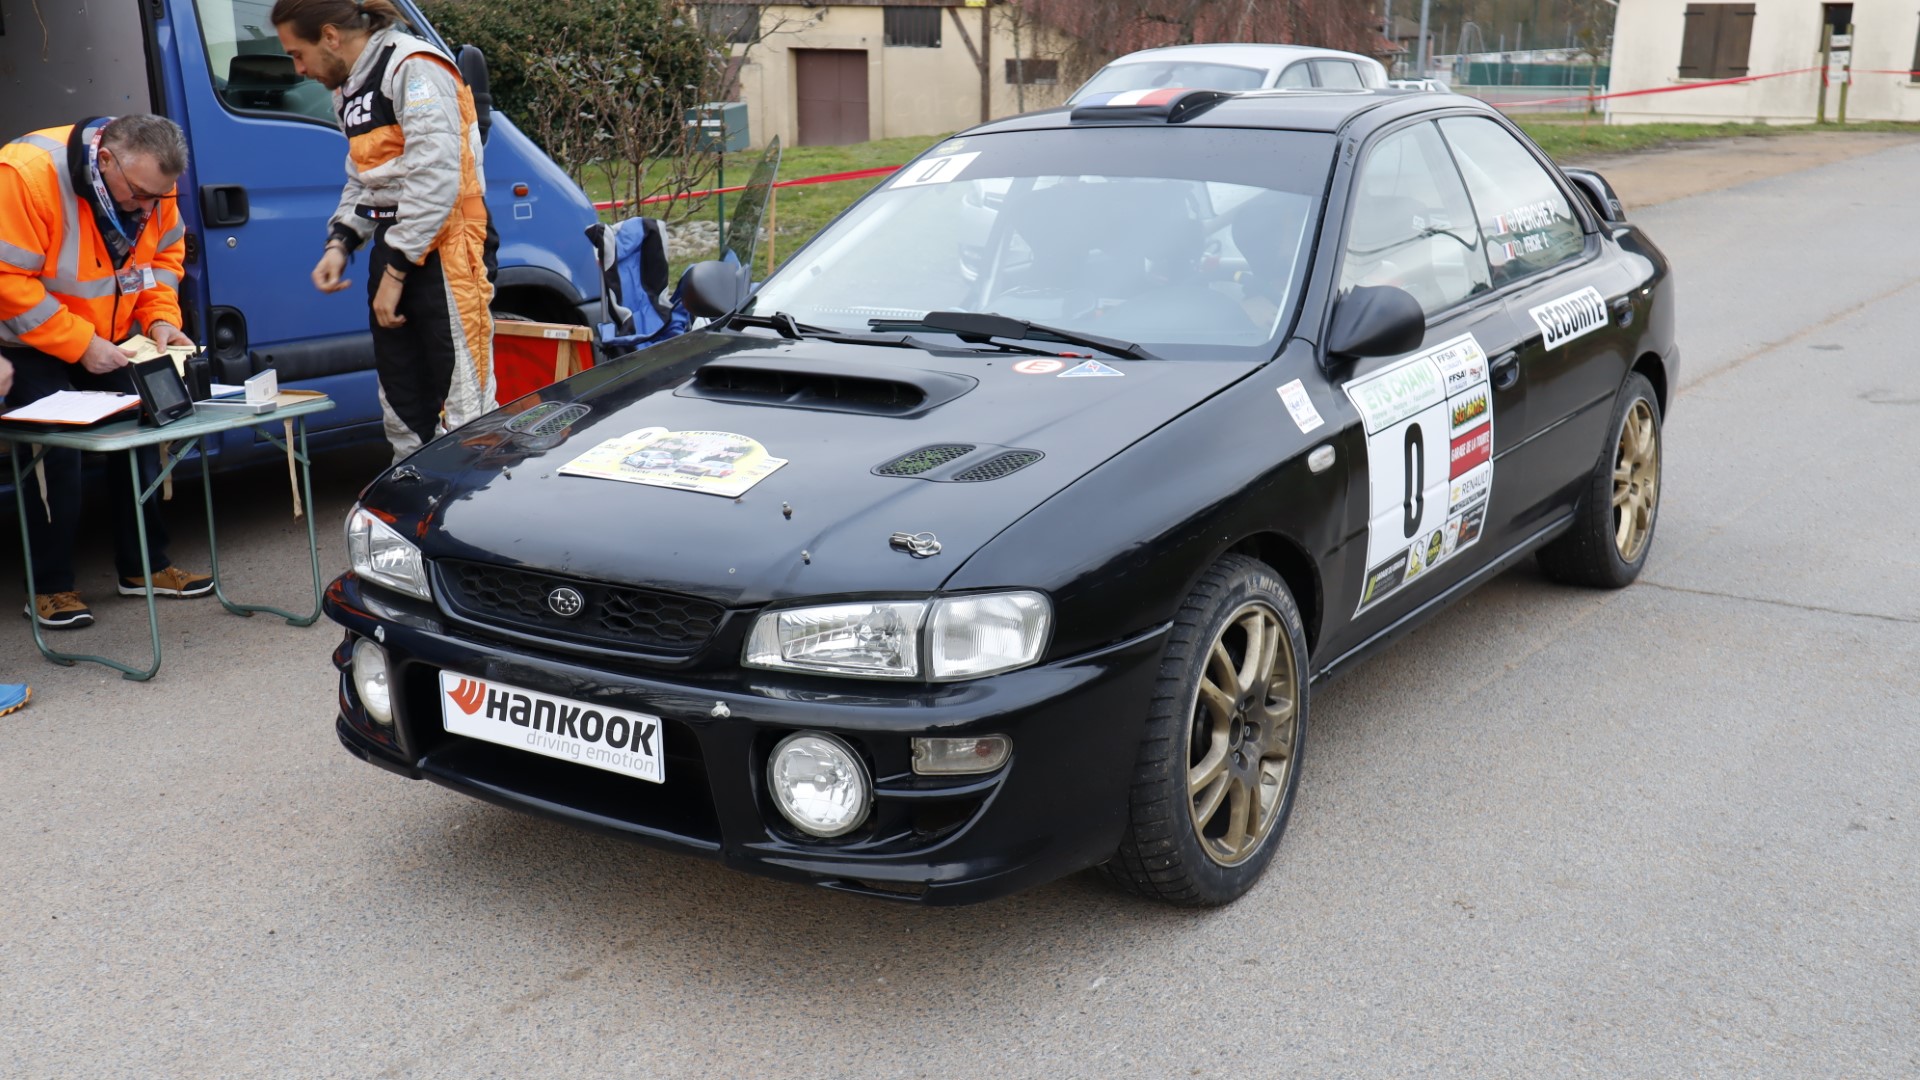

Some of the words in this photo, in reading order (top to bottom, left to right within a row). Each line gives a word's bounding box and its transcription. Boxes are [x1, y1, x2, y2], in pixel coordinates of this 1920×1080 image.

[1023, 361, 1053, 371] E
[1388, 360, 1436, 398] CHANU
[1404, 422, 1424, 539] 0
[1461, 469, 1489, 496] RENAULT
[1259, 575, 1300, 631] MICHELIN
[526, 730, 581, 760] driving
[586, 747, 655, 774] emotion
